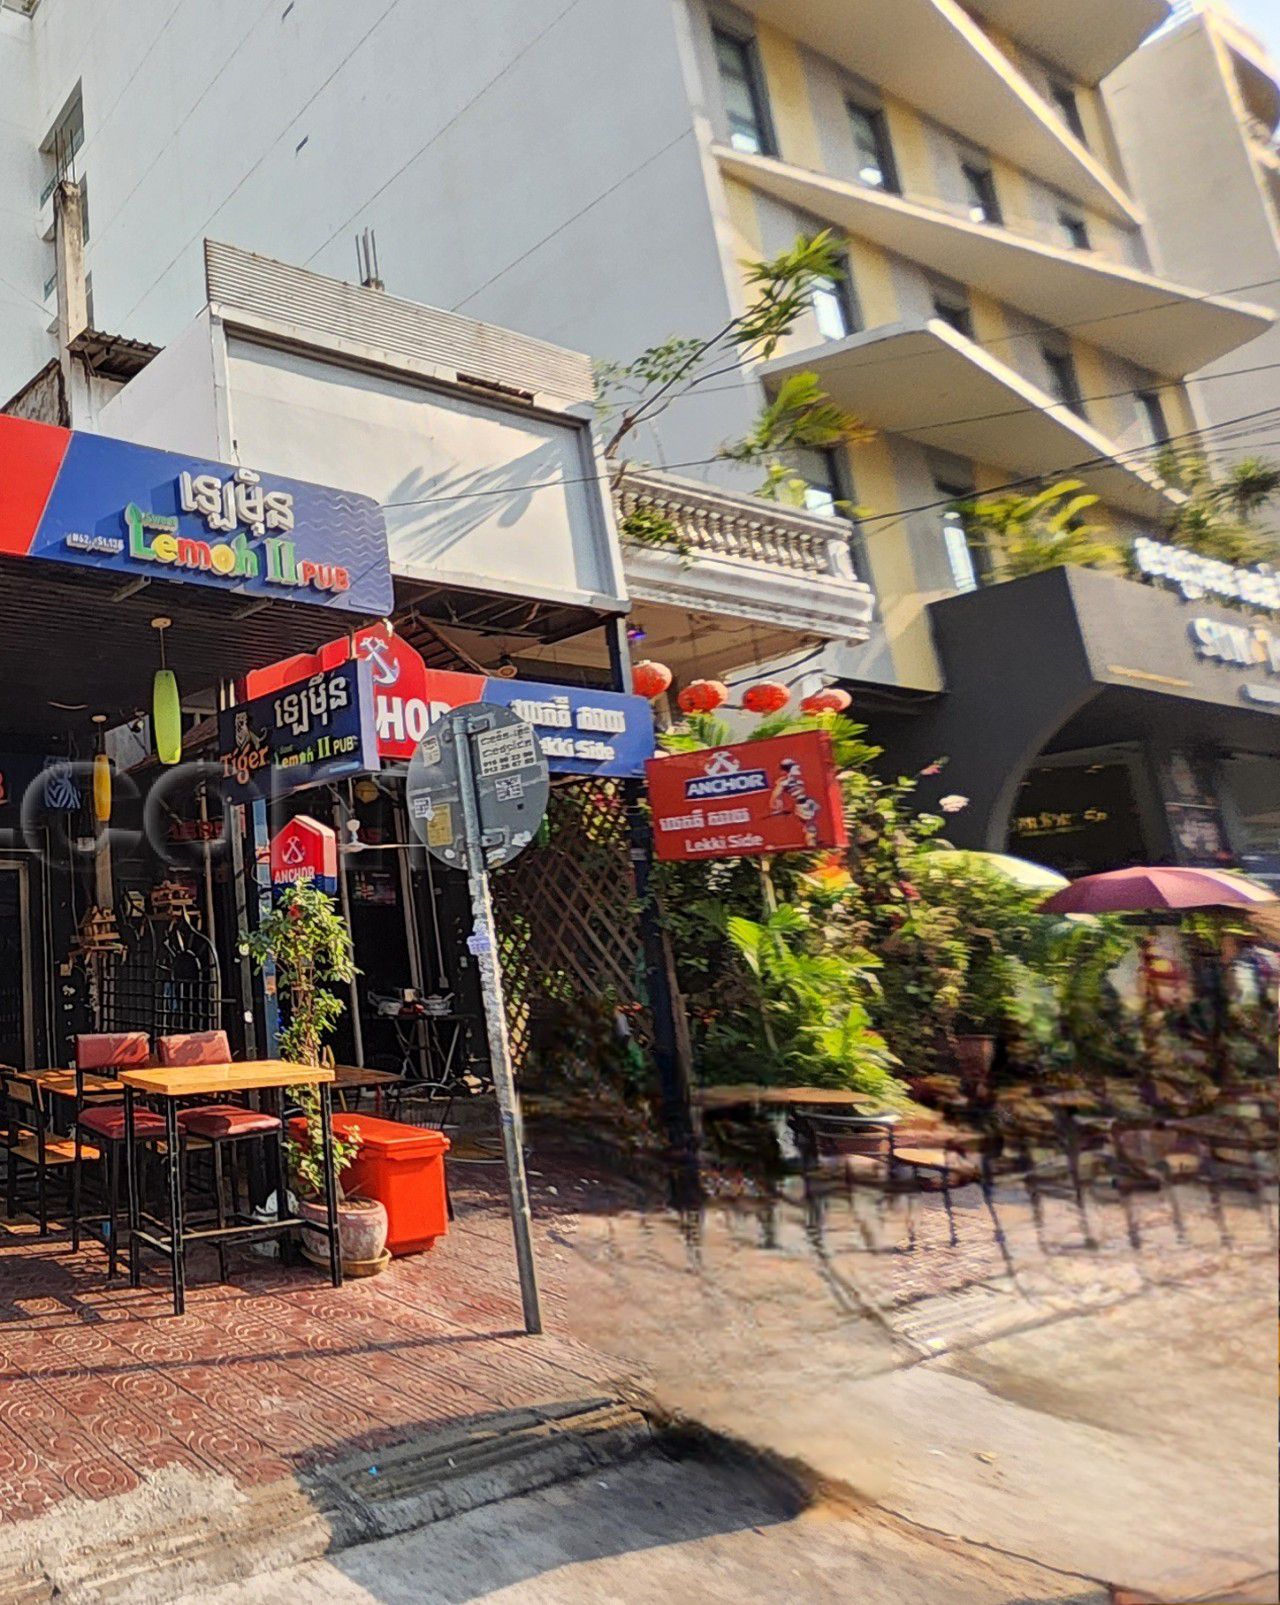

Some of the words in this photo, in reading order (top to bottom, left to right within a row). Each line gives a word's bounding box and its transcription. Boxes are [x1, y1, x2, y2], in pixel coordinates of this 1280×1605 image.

[125, 502, 259, 577] Lemon
[298, 559, 350, 591] PUB
[275, 746, 314, 770] Lemon
[333, 737, 354, 755] PUB
[575, 740, 615, 761] Side
[220, 745, 269, 785] Tiger
[687, 773, 765, 796] ANCHOR
[685, 835, 727, 852] Lekki
[727, 833, 764, 848] Side
[274, 866, 315, 884] ANCHOR
